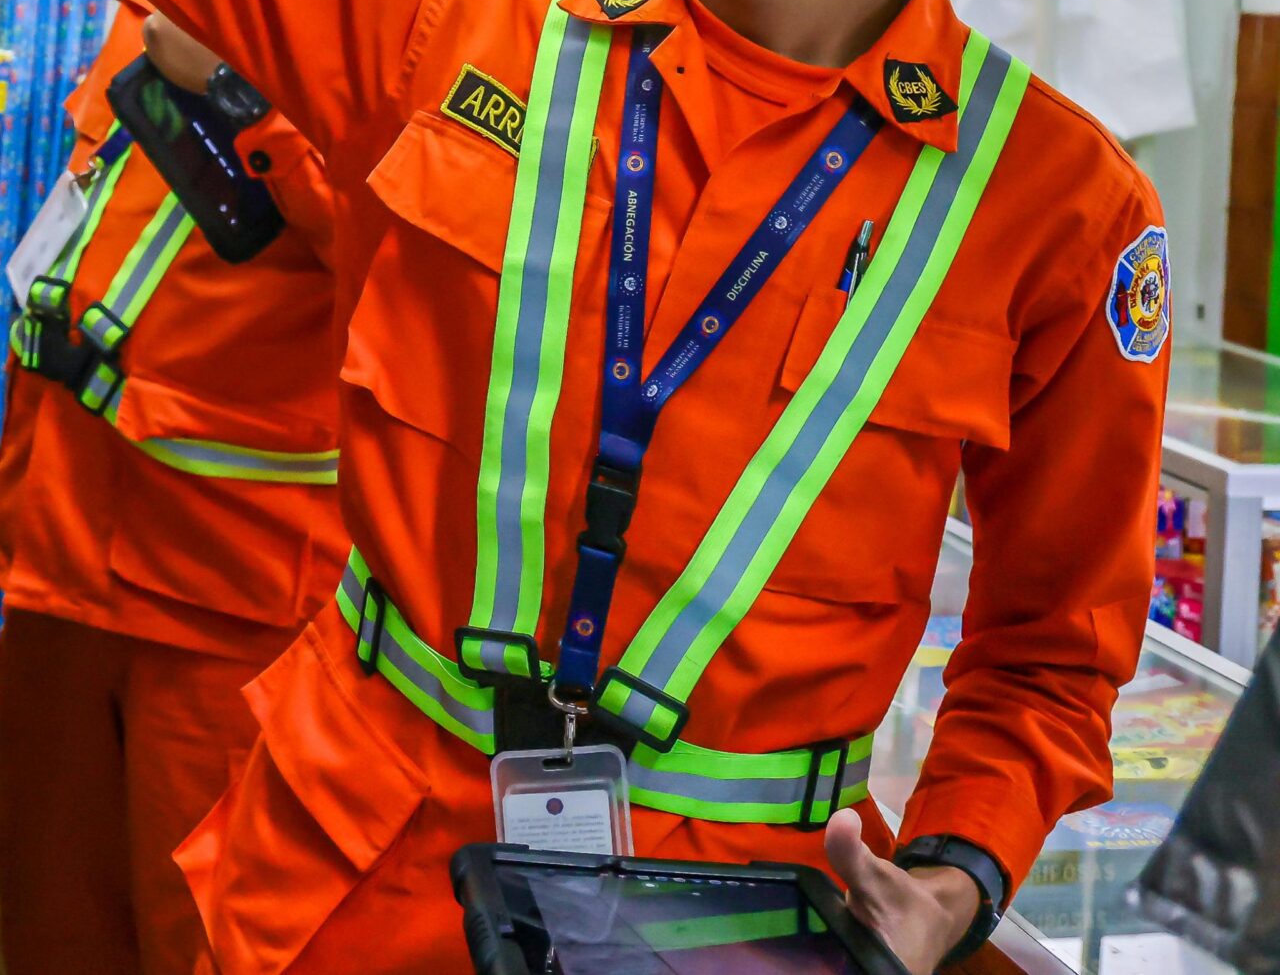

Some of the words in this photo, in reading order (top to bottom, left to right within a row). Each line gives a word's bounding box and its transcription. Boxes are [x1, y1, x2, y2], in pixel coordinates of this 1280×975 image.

[460, 85, 526, 146] ARR
[898, 80, 927, 95] CBES
[623, 189, 637, 262] ABNEGACIÓN
[726, 249, 770, 303] DISCIPLINA
